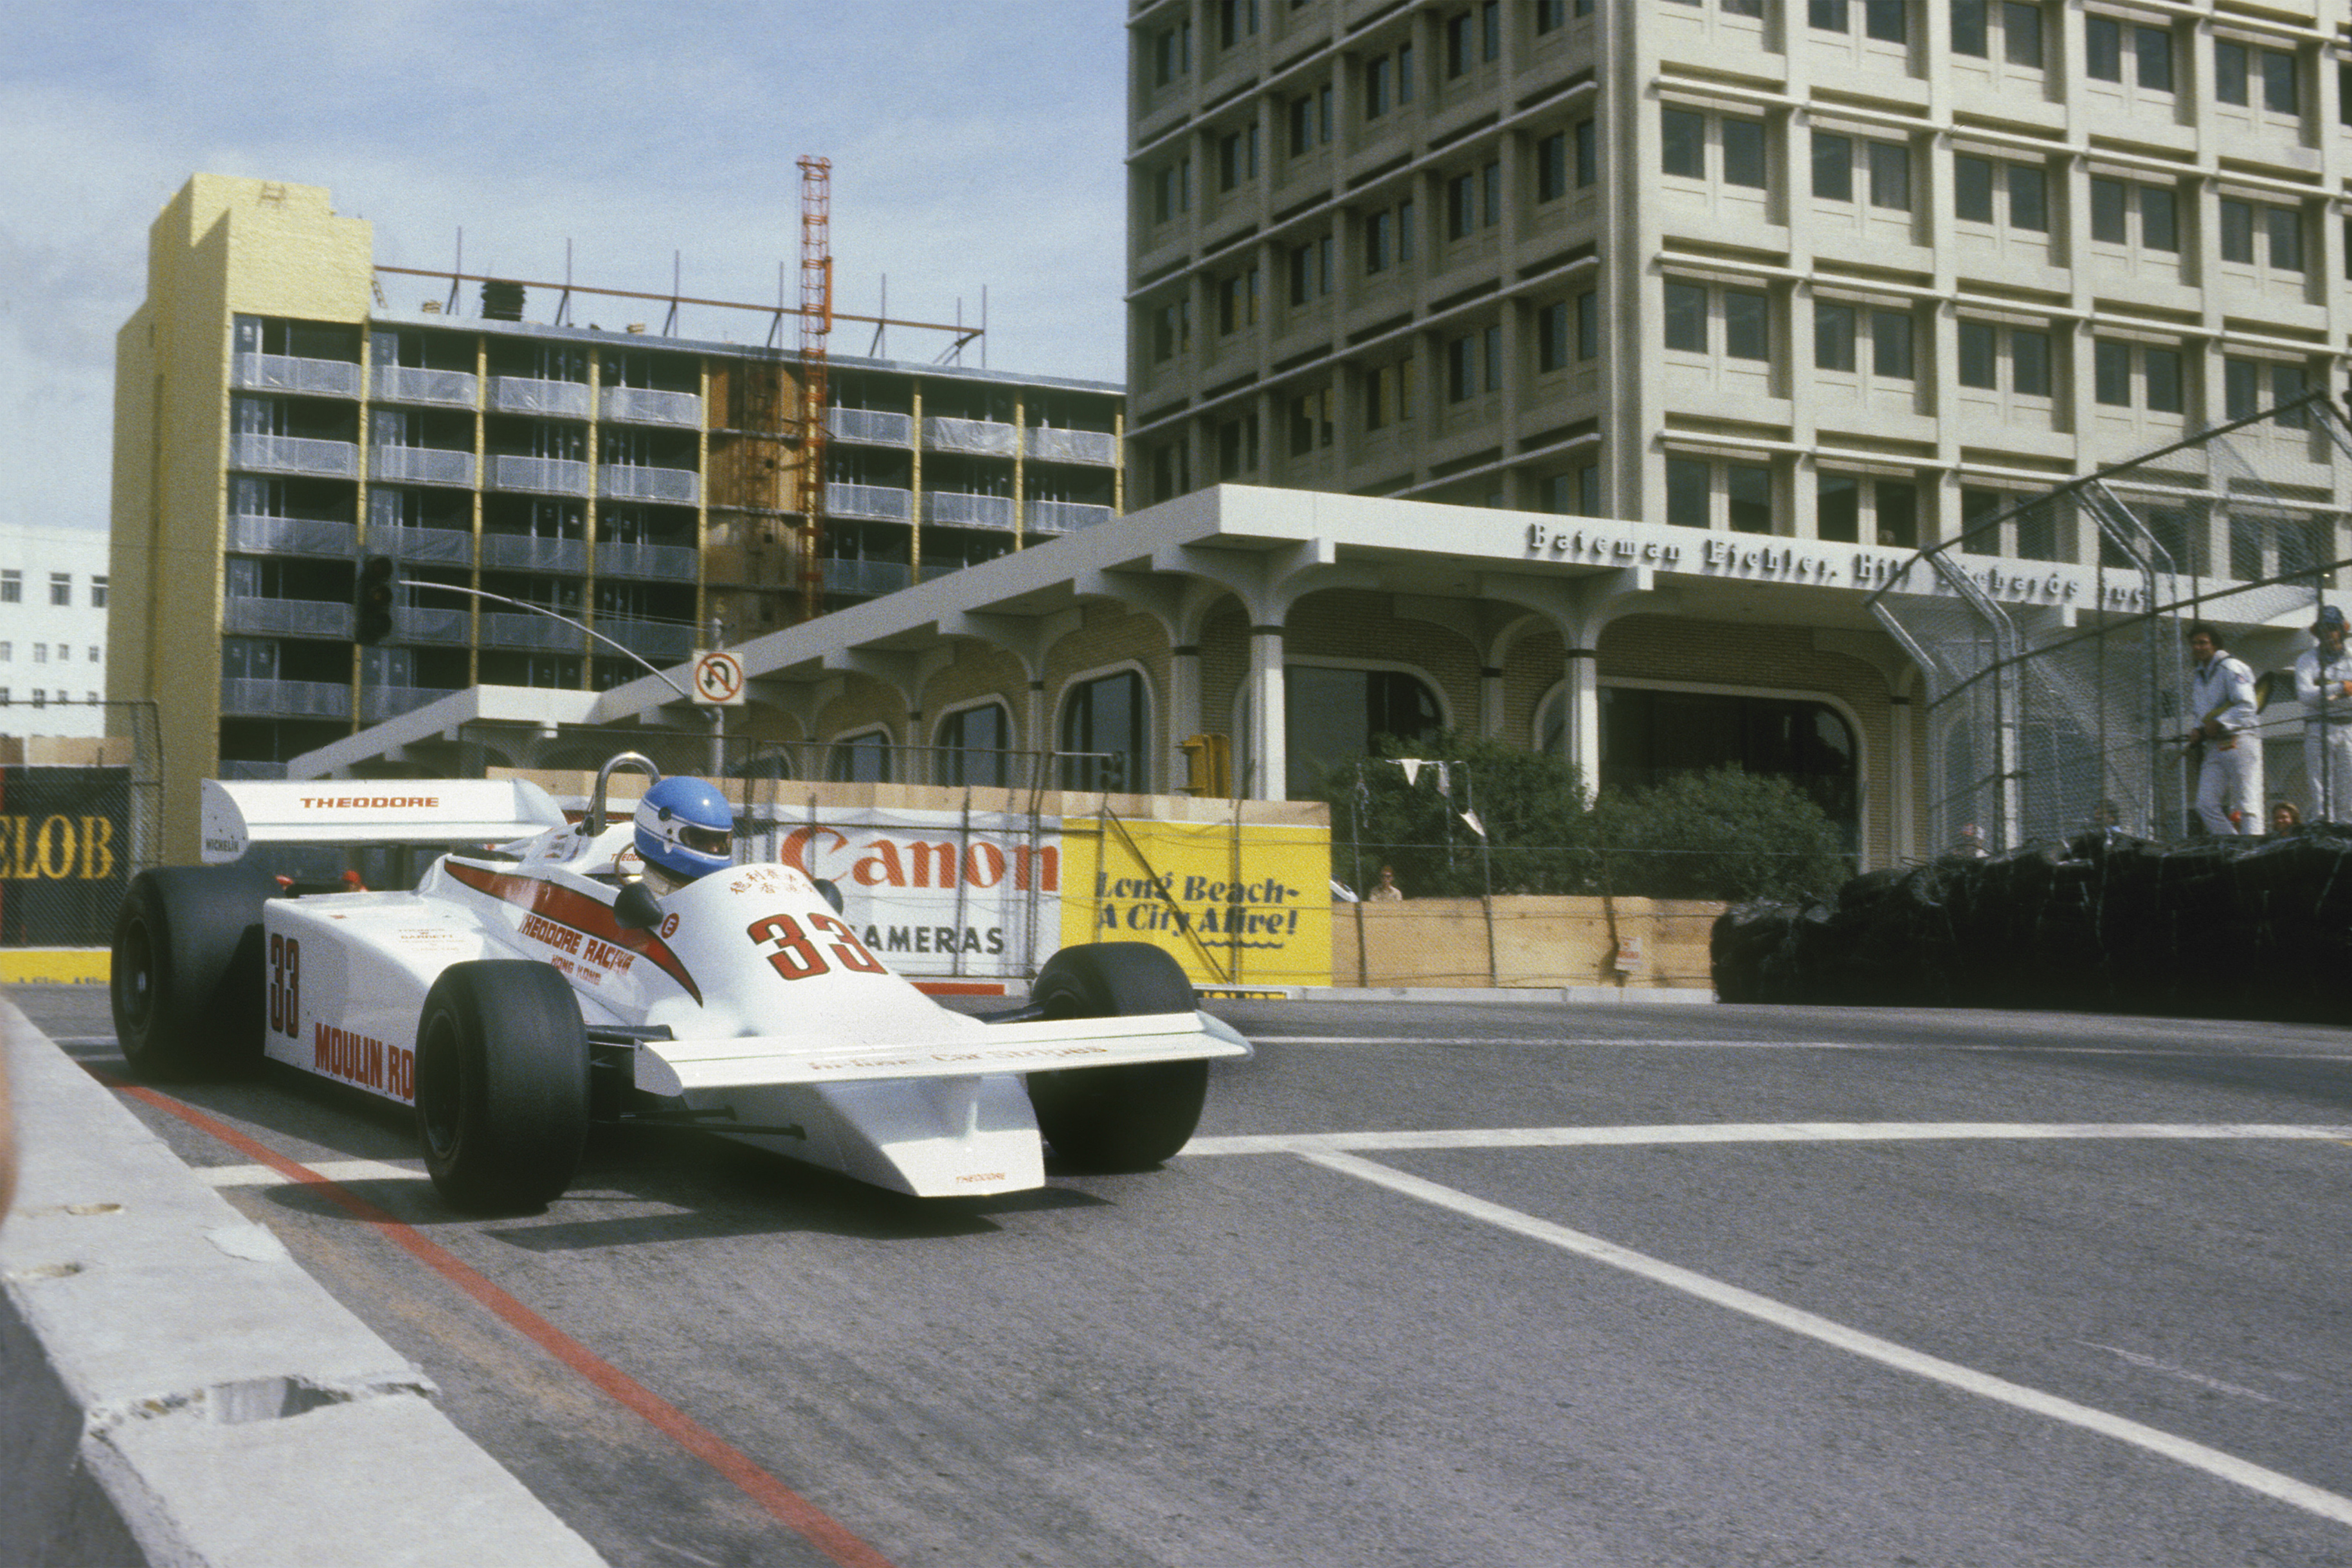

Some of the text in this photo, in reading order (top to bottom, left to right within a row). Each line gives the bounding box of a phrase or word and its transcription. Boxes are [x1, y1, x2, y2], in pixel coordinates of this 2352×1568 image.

[1529, 523, 1681, 560] Bateman
[1936, 563, 2078, 595] chards
[300, 797, 439, 808] THEODORE
[781, 826, 1058, 891] Canon
[1095, 871, 1174, 901] Long
[518, 912, 636, 976] THEODORE RACING
[747, 912, 889, 981] 33
[849, 924, 1005, 955] AMERAS
[1099, 903, 1298, 937] A City Alive!
[270, 932, 300, 1039] 33
[550, 954, 601, 986] HONG KONG
[315, 1022, 383, 1090] MOULIN
